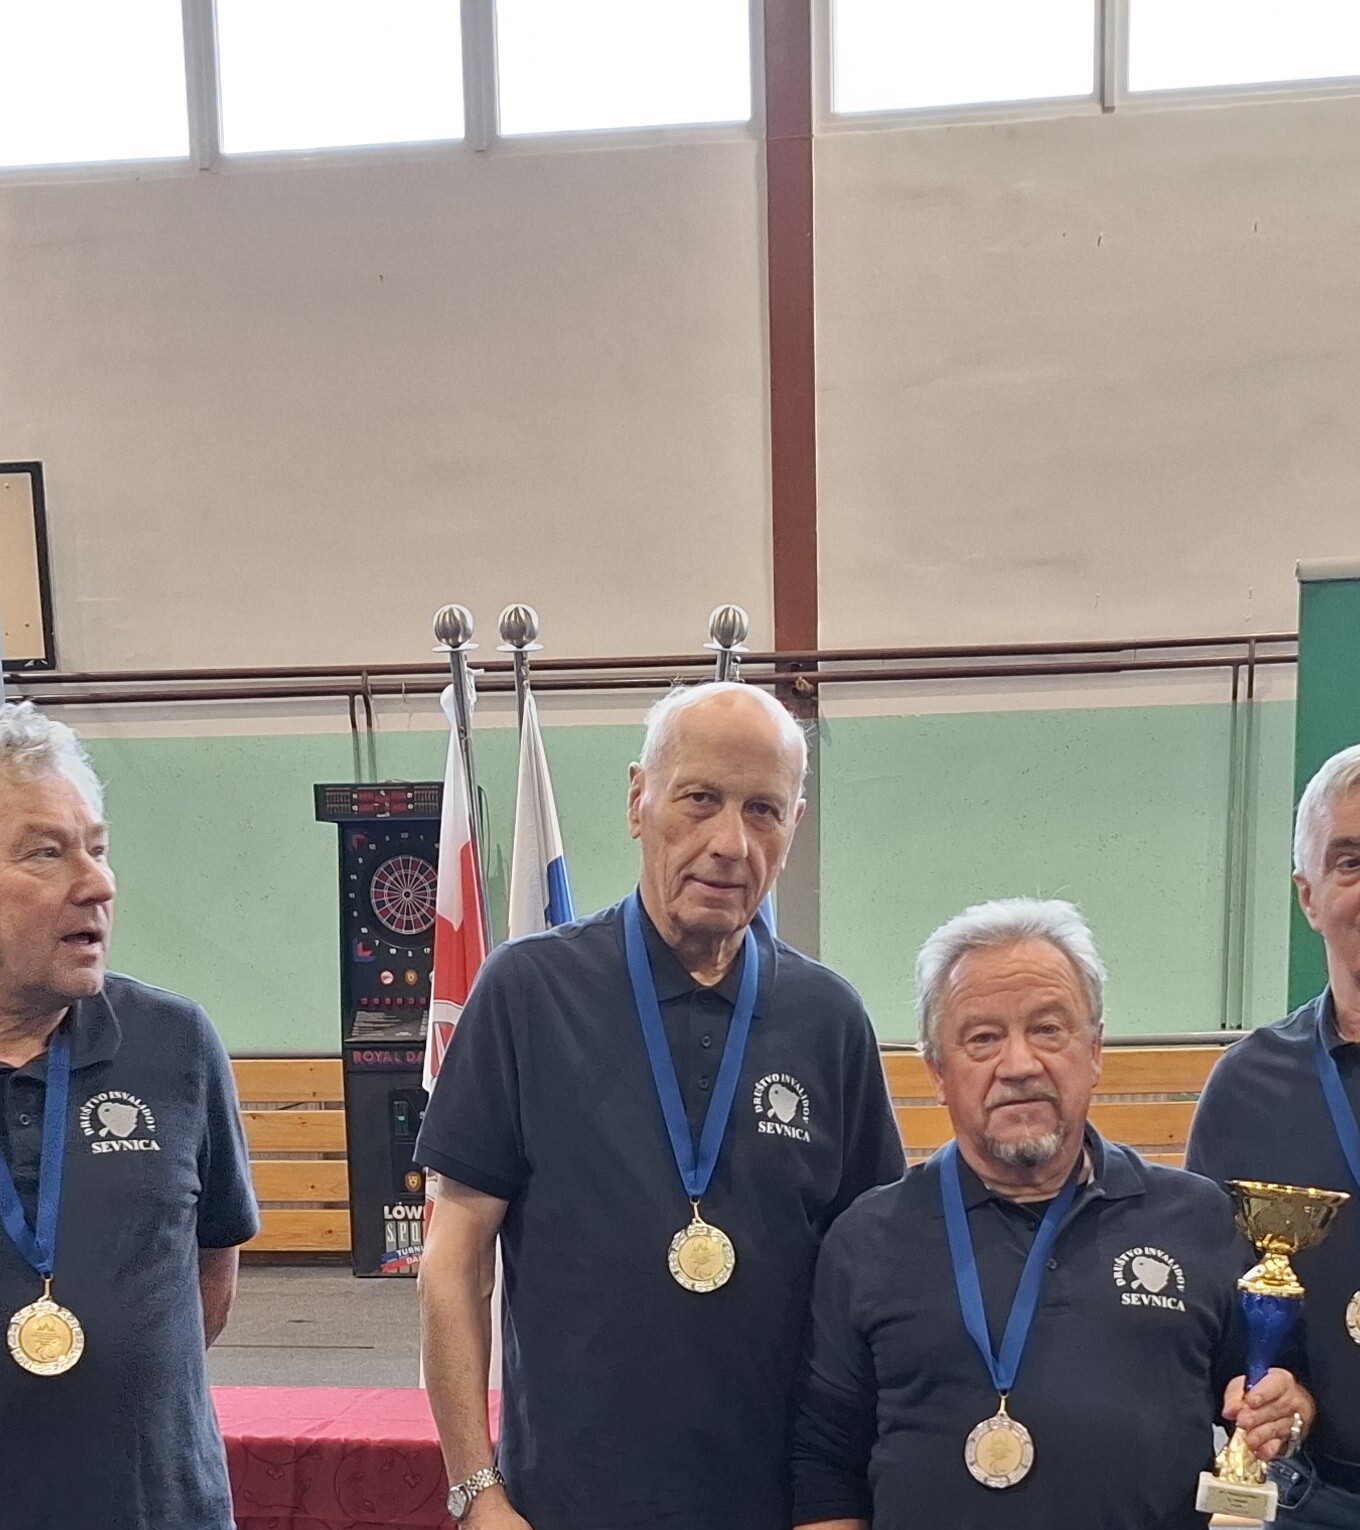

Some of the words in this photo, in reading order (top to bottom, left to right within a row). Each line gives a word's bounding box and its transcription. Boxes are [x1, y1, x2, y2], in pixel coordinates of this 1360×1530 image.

[352, 1051, 401, 1064] ROYAL
[758, 1120, 811, 1142] SEVNICA
[91, 1140, 161, 1154] SEVNICA
[384, 1202, 424, 1220] LÖW
[386, 1221, 421, 1243] SPO
[1121, 1292, 1186, 1312] SEVNICA
